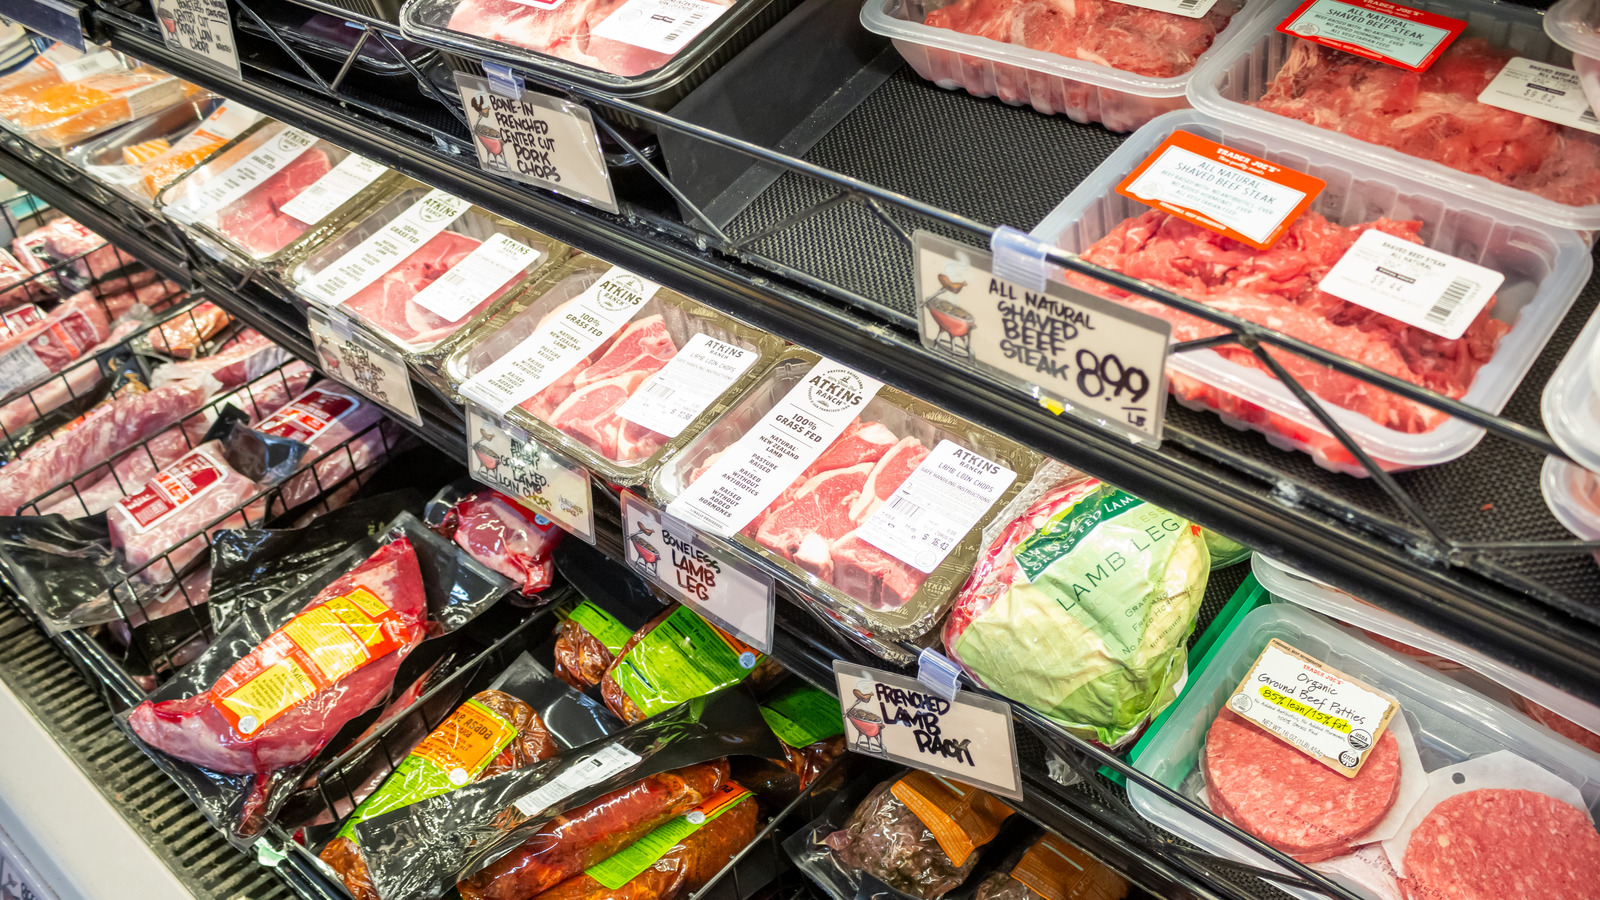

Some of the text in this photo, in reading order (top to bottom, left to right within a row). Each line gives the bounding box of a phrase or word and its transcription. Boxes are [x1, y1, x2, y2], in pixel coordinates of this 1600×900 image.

[1327, 8, 1365, 24] SHAVED
[1366, 20, 1390, 30] BEEF
[1391, 27, 1424, 40] STEAK
[1347, 8, 1364, 16] ALL
[1366, 12, 1408, 28] NATURAL
[489, 95, 534, 116] BONE-IN
[495, 113, 548, 136] FRENCHED
[283, 130, 312, 148] ATKINS
[500, 128, 555, 152] CENTER CUT
[513, 143, 552, 166] PORK
[1216, 148, 1278, 172] TRADER JOE'S
[517, 160, 561, 182] CHOPS
[1199, 162, 1260, 189] ALL NATURAL
[1175, 162, 1277, 204] SHAVED BEEF STEAK
[424, 198, 457, 217] ATKINS
[500, 238, 530, 255] ATKINS
[600, 281, 642, 305] ATKINS
[604, 292, 625, 306] RANCH
[989, 278, 1096, 330] ALL NATURAL
[566, 314, 602, 336] GRASS FED
[580, 313, 600, 326] 100%
[998, 301, 1078, 342] SHAVED
[554, 340, 567, 350] LAMB
[1002, 318, 1066, 356] BEEF
[704, 340, 744, 358] ATKINS
[1000, 340, 1070, 381] STEAK
[1076, 348, 1150, 404] 8.99
[809, 375, 862, 406] ATKINS
[816, 390, 842, 406] RANCH
[776, 414, 822, 442] GRASS FED
[792, 414, 816, 430] 100%
[760, 436, 800, 460] NEW ZEALAND
[766, 446, 783, 458] LAMB
[770, 434, 796, 452] NATURAL
[748, 459, 771, 474] RAISED
[752, 453, 778, 470] PASTURE
[953, 448, 1000, 474] ATKINS
[959, 461, 983, 476] RANCH
[722, 473, 760, 496] ANTIBIOTICS
[732, 471, 759, 488] WITHOUT
[739, 468, 762, 482] RAISED
[921, 467, 990, 504] SAFE HANDLING INSTRUCTIONS
[938, 462, 994, 492] LAMB LOIN CHOPS
[499, 474, 520, 493] LOIN
[523, 487, 552, 512] CHOPS
[710, 496, 731, 510] ADDED
[712, 489, 740, 507] WITHOUT
[719, 486, 742, 501] RAISED
[698, 497, 732, 518] HORMONES
[1078, 510, 1102, 533] FED
[1104, 496, 1136, 513] LAM
[662, 530, 721, 574] BONELESS
[672, 549, 716, 588] LAMB
[1056, 551, 1127, 612] LAMB
[1130, 518, 1180, 552] LEG
[676, 570, 710, 601] LEG
[1297, 673, 1338, 695] Organic
[1302, 664, 1342, 685] TRADER JOE'S
[875, 683, 950, 716] FRENCHED
[1258, 673, 1296, 694] Ground
[1299, 689, 1328, 710] Beef
[1330, 702, 1366, 724] Patties
[1262, 690, 1287, 705] 85%
[1331, 718, 1348, 730] fat
[880, 702, 942, 737] LAMB
[1261, 702, 1276, 710] Added
[1308, 722, 1324, 731] Added
[1262, 718, 1274, 728] NET
[1288, 734, 1298, 742] OZ
[1310, 746, 1324, 758] 454g
[1308, 728, 1318, 736] Fed
[1354, 732, 1368, 742] USDA
[912, 729, 976, 767] RACK
